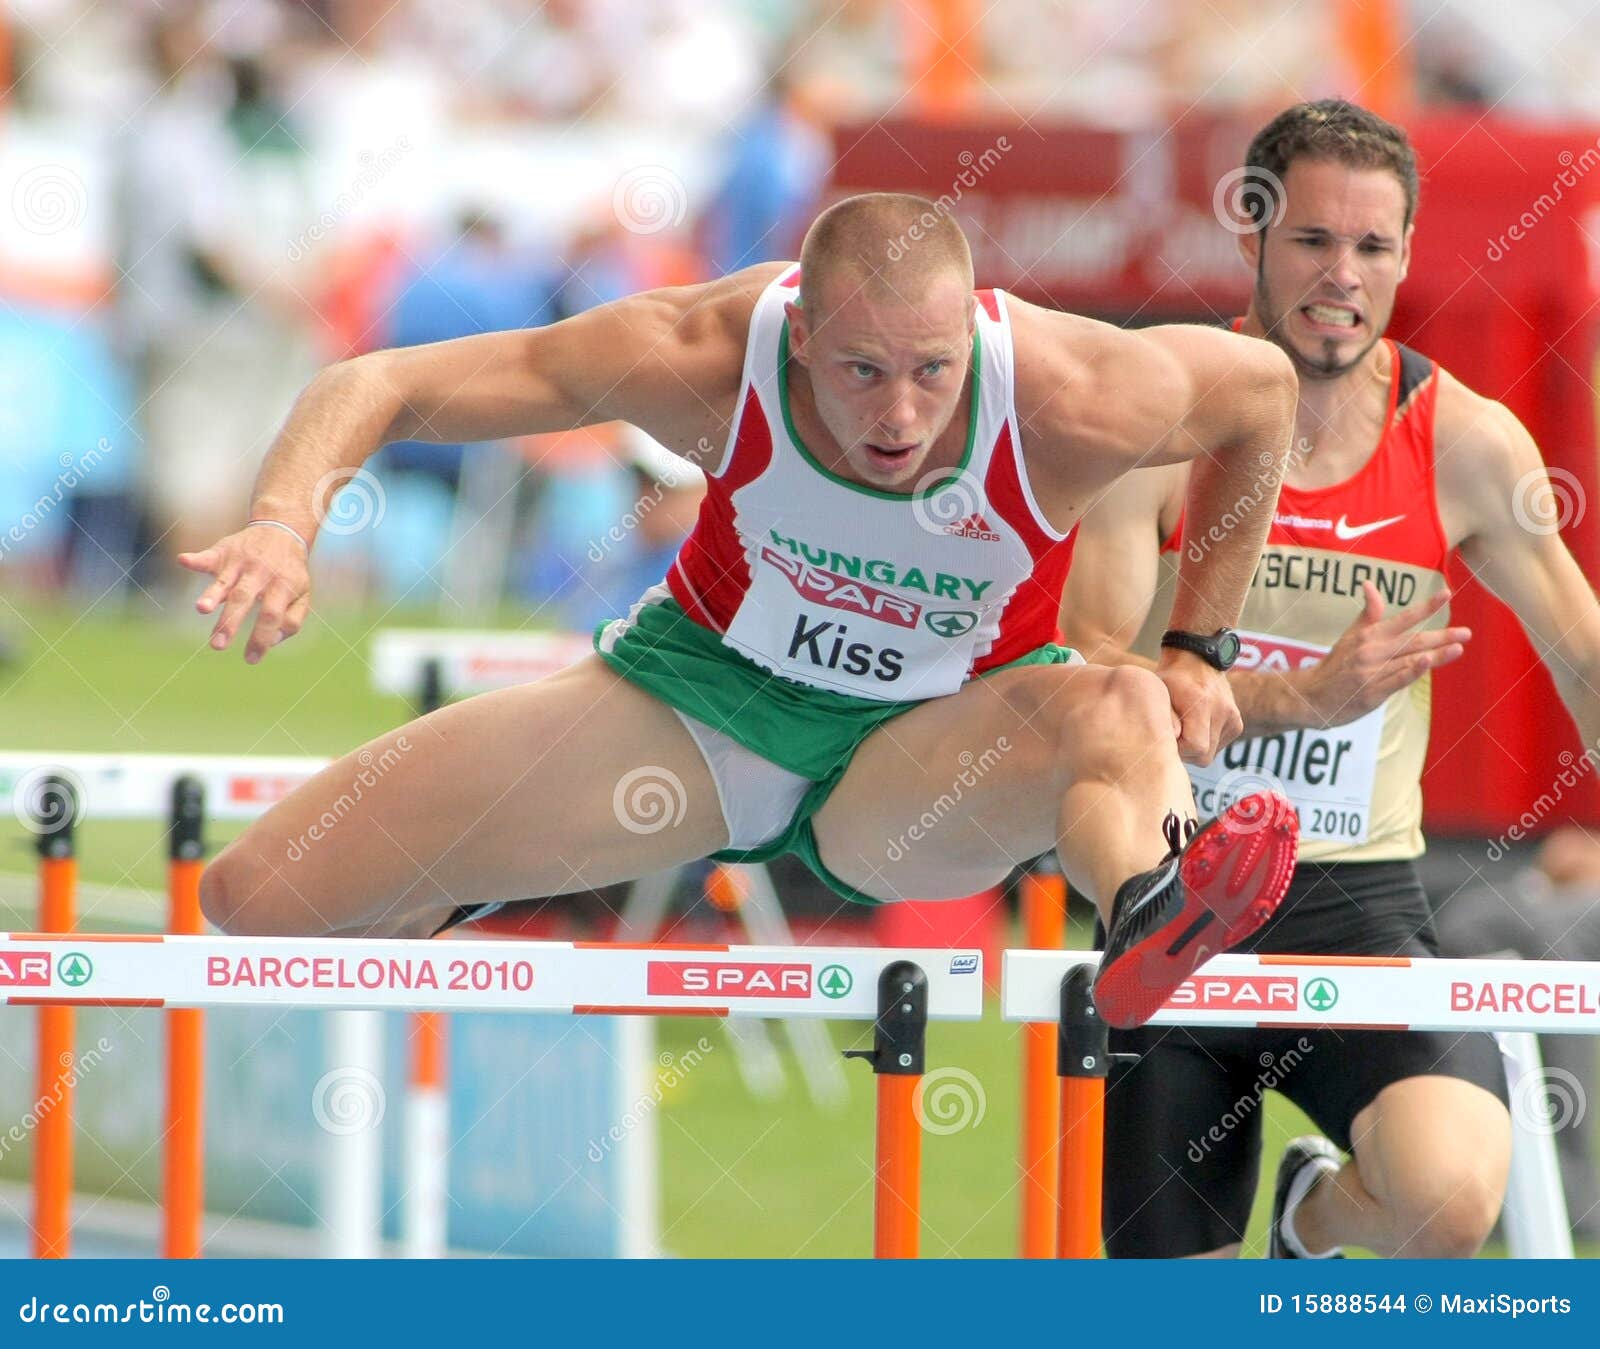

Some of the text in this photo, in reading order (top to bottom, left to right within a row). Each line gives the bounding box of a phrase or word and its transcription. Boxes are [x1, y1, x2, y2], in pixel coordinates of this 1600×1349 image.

[944, 526, 1001, 542] adidas
[769, 528, 993, 600] HUNGARY
[788, 614, 905, 682] Kiss
[1310, 808, 1362, 837] 2010
[207, 955, 534, 991] BARCELONA 2010
[682, 967, 808, 992] SPAR
[1168, 980, 1295, 1006] SPAR
[1450, 981, 1600, 1014] BARCEL
